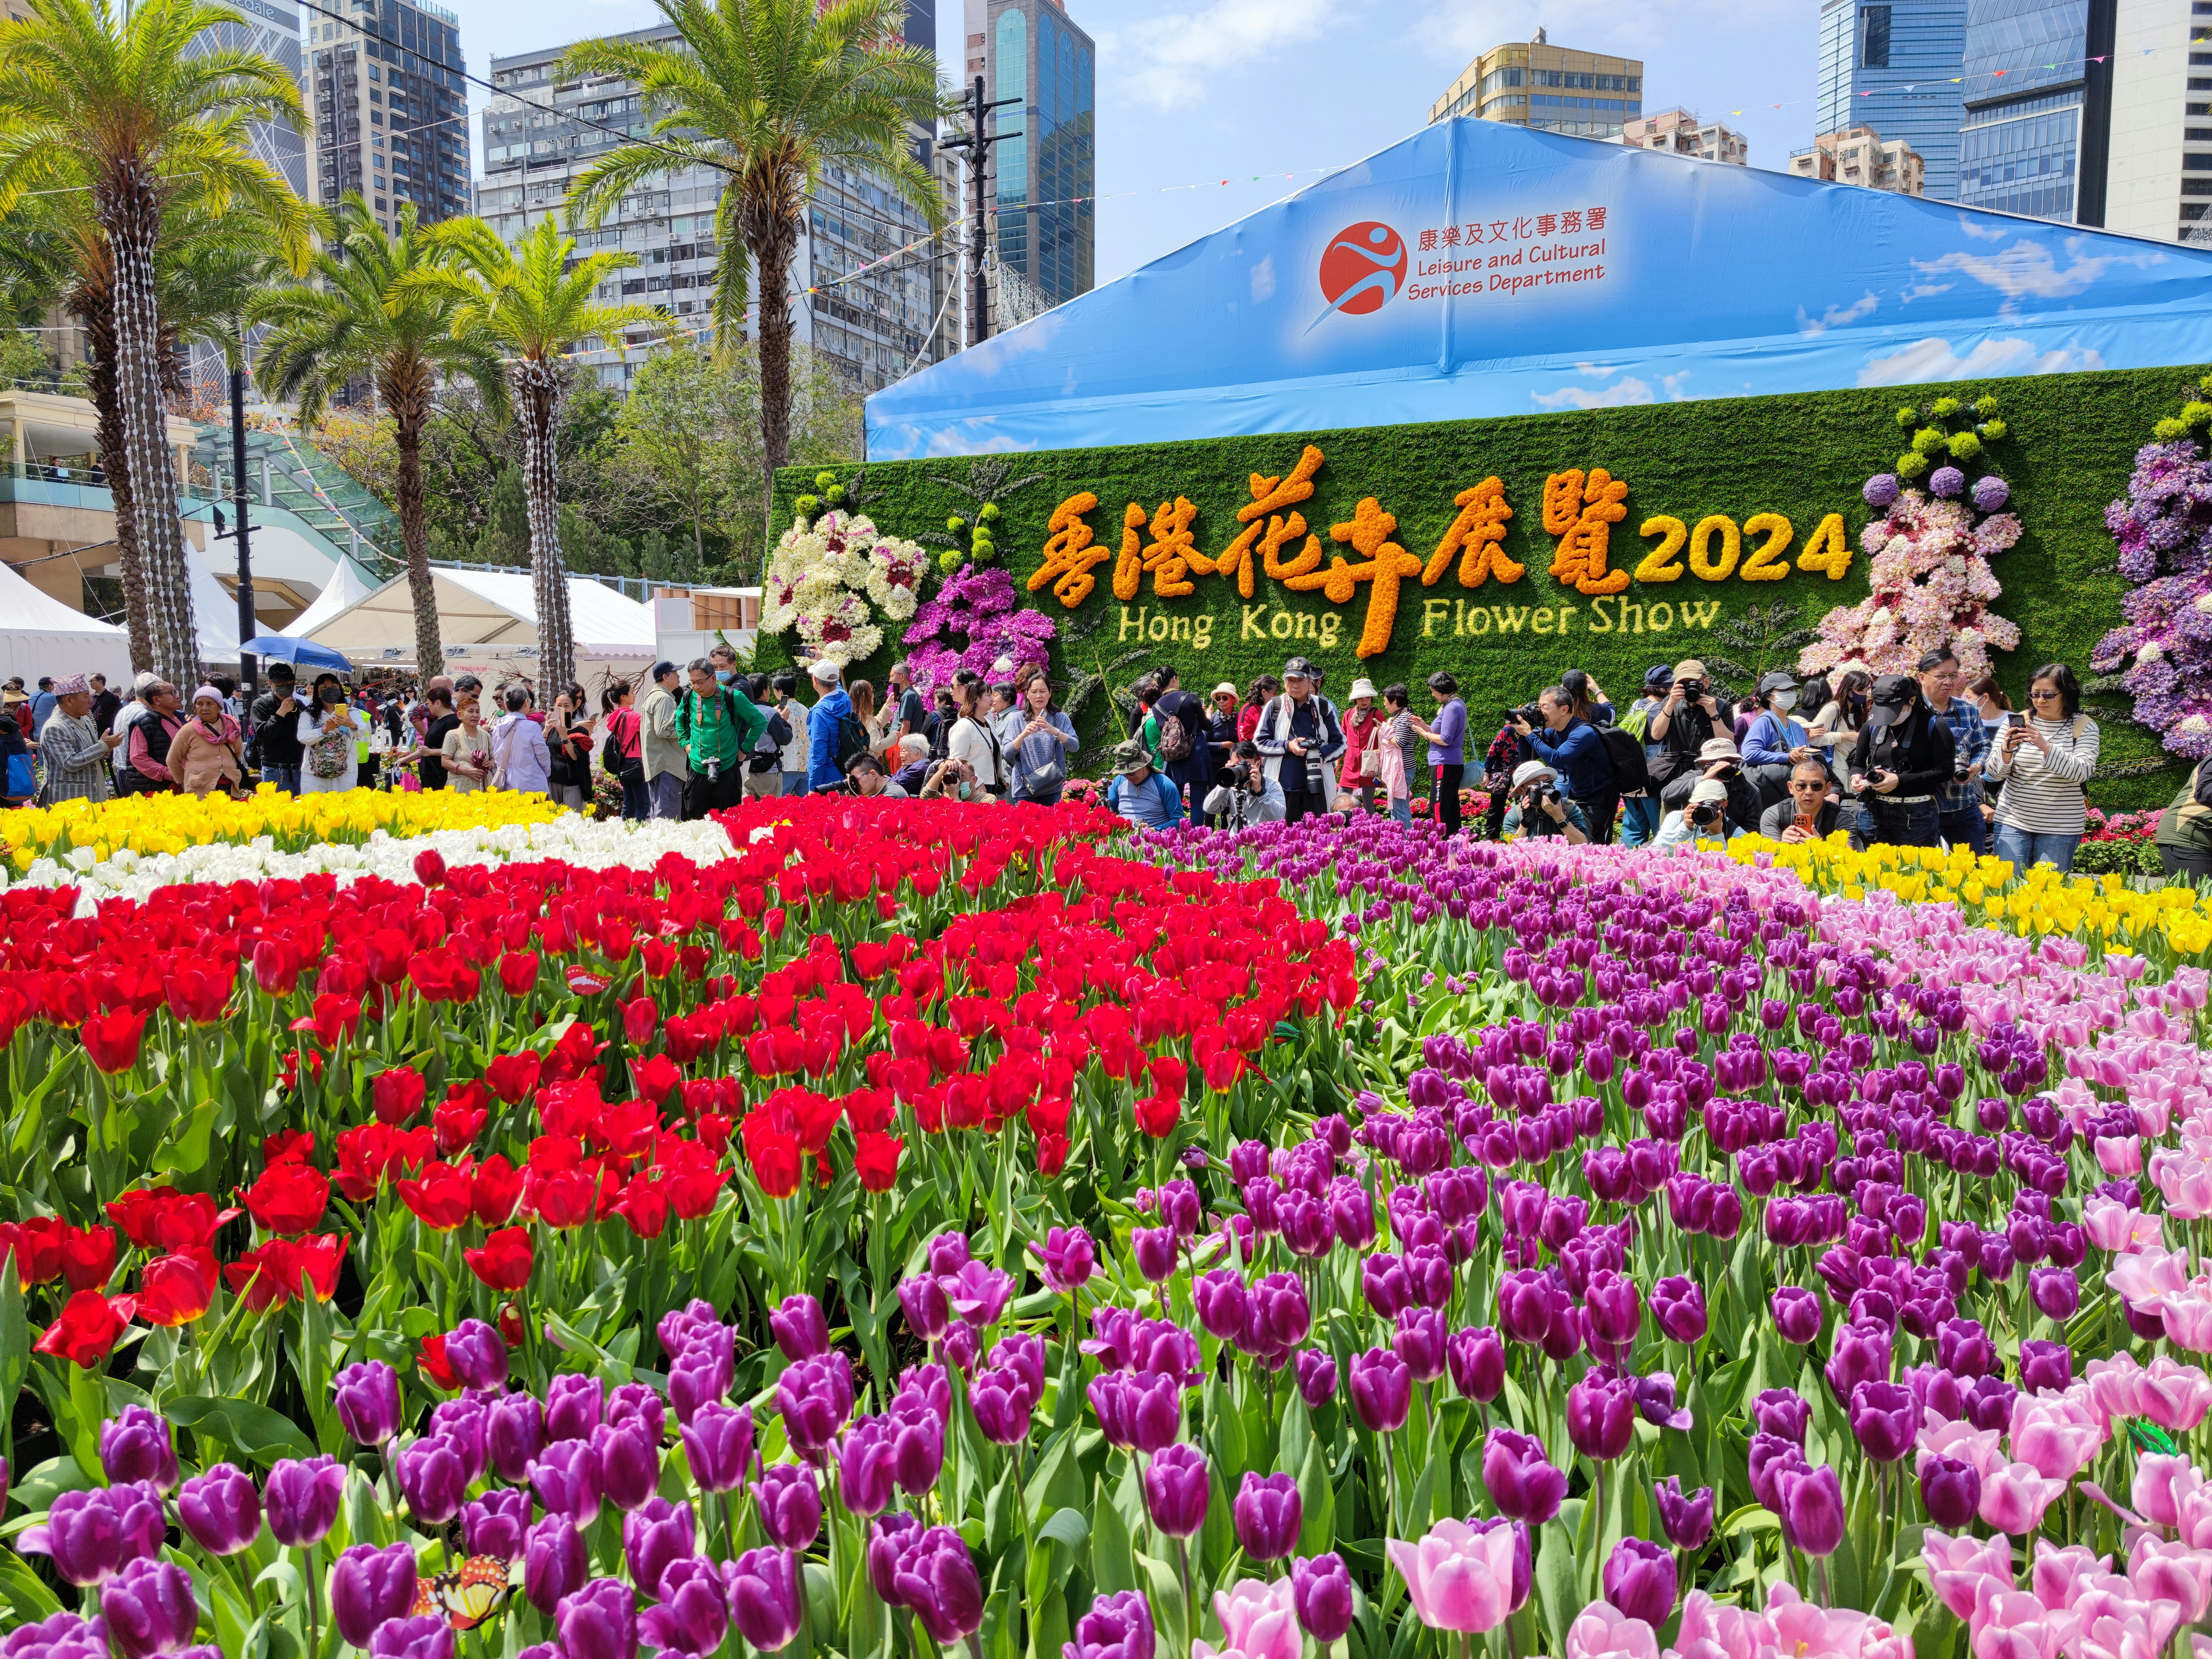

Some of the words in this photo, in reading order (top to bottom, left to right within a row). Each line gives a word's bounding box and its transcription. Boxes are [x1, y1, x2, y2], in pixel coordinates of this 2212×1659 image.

[228, 0, 275, 19] edale
[1418, 207, 1606, 251] 康樂及文化事務署
[1418, 257, 1482, 276] Leisure
[1488, 249, 1522, 268] and
[1529, 238, 1605, 263] Cultural
[1408, 281, 1483, 300] Services
[1490, 265, 1605, 295] Department
[1027, 445, 1630, 658] 香港花卉展覽
[1634, 513, 1852, 581] 2024
[1118, 606, 1213, 650] Hong
[1241, 604, 1342, 650] Kong
[1422, 599, 1578, 636] Flower
[1588, 595, 1721, 634] Show
